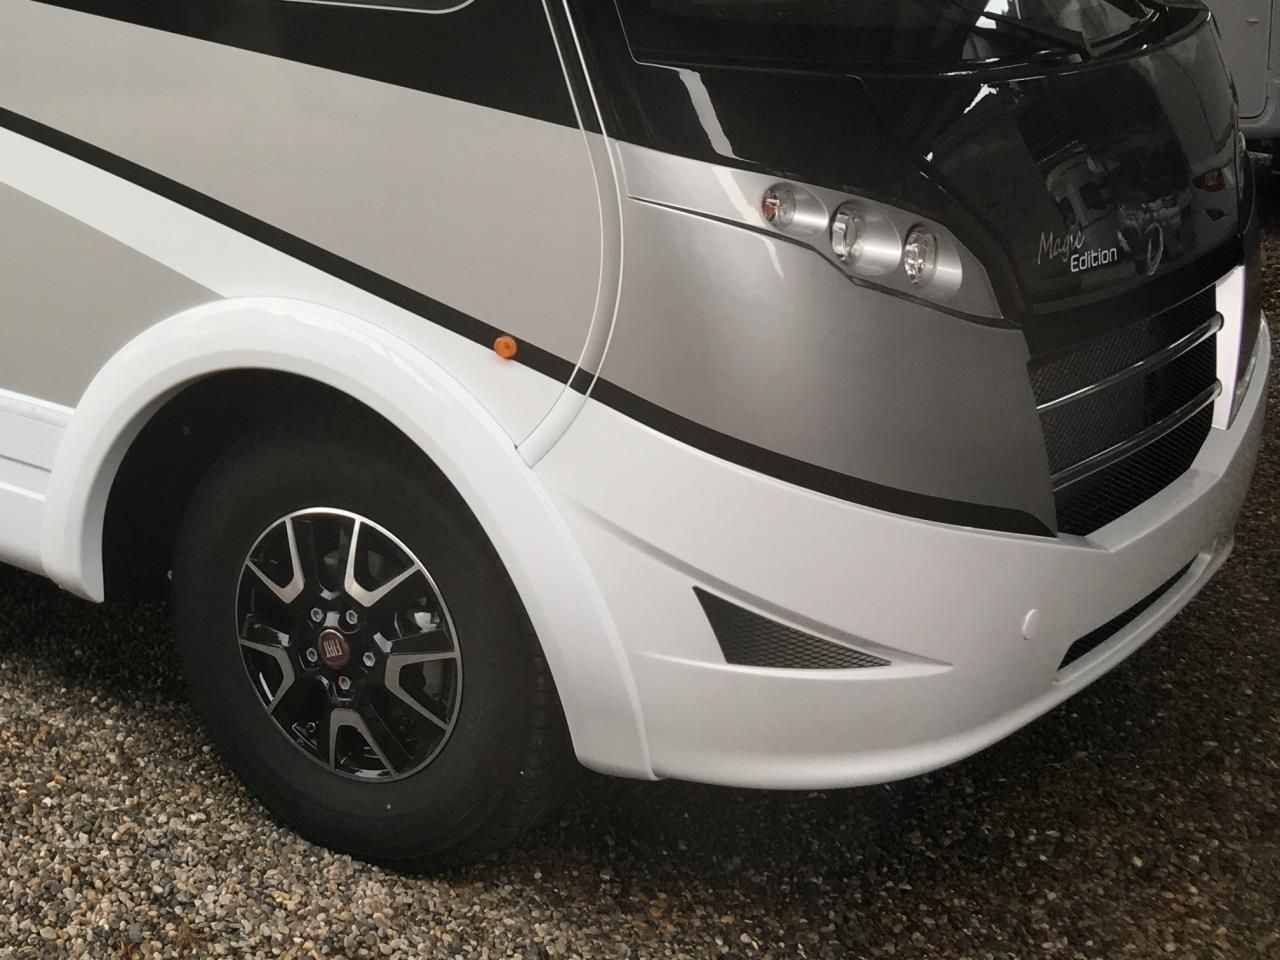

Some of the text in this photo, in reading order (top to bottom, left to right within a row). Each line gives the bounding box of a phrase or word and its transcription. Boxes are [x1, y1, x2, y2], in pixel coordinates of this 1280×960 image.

[1038, 230, 1085, 265] Magic
[1070, 247, 1118, 273] Edition
[323, 639, 343, 658] FIAT
